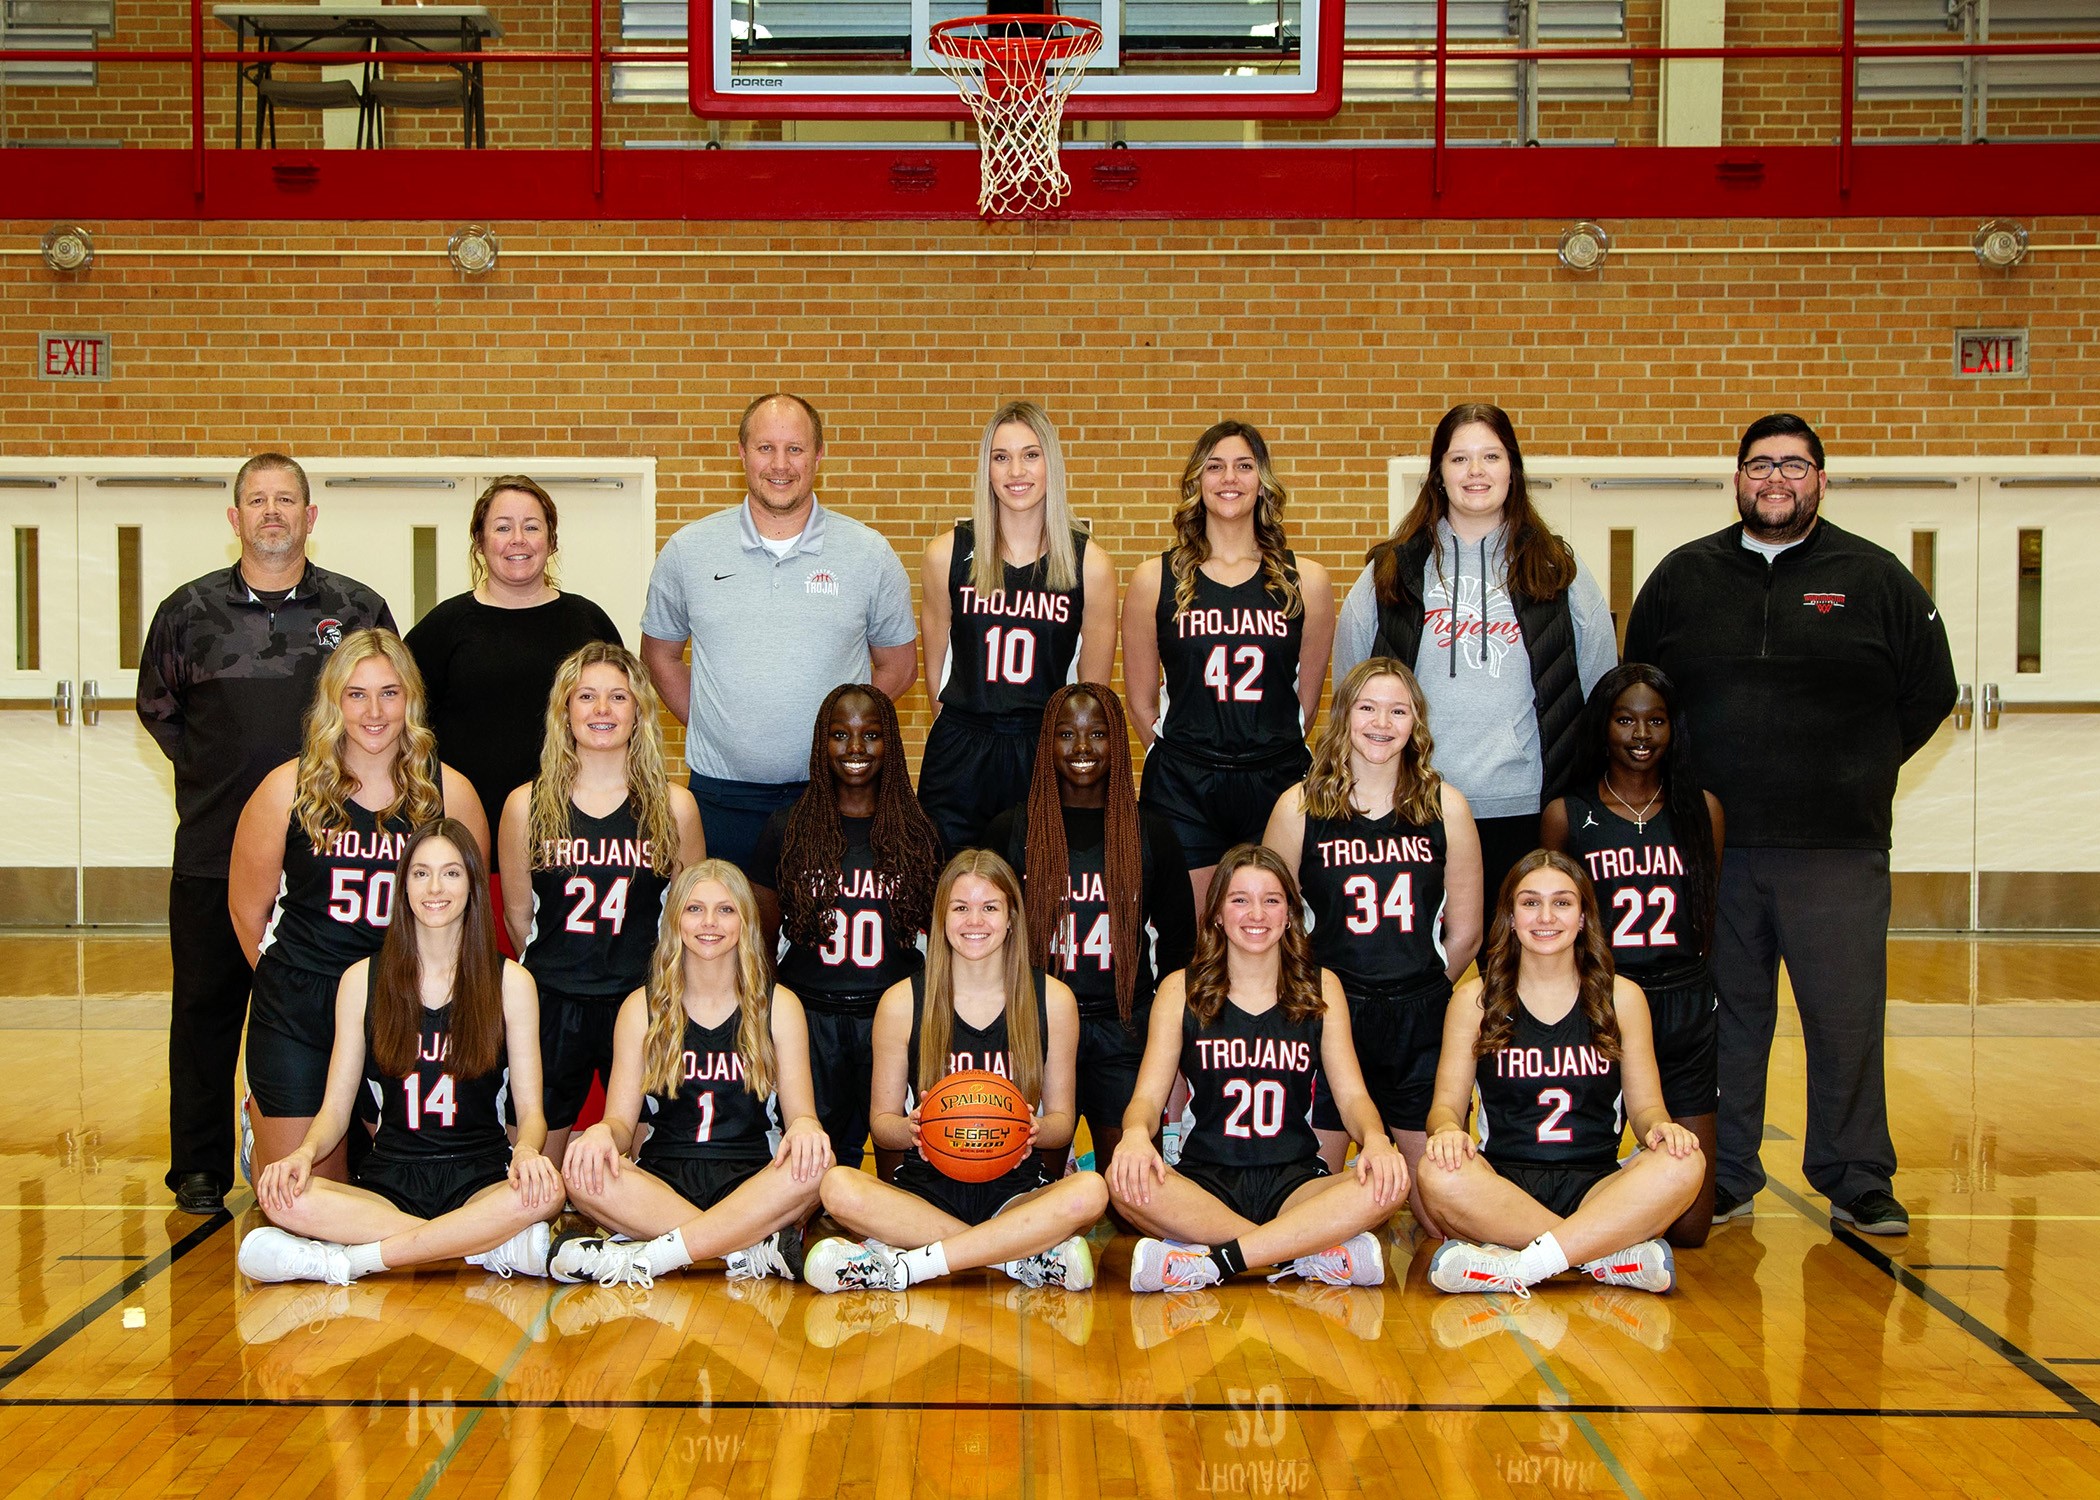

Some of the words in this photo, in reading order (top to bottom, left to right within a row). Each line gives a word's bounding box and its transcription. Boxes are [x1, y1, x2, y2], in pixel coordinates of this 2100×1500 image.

[46, 339, 104, 376] EXIT
[1961, 337, 2016, 373] EXIT
[803, 580, 840, 597] TROJAN
[1177, 607, 1289, 639] TROJANS
[985, 625, 1037, 685] 10
[1204, 644, 1266, 702] 42
[1317, 836, 1434, 869] TROJANS
[327, 867, 397, 929] 50
[564, 876, 630, 936] 24
[1342, 871, 1416, 936] 34
[1611, 885, 1679, 948] 22
[818, 907, 884, 969] 30
[1194, 1037, 1311, 1073] TROJANS
[402, 1071, 459, 1131] 14
[695, 1090, 715, 1143] 1
[939, 1092, 1014, 1114] SPALDING
[1222, 1077, 1287, 1139] 20
[1536, 1086, 1573, 1143] 2
[943, 1125, 1011, 1140] LEGACY
